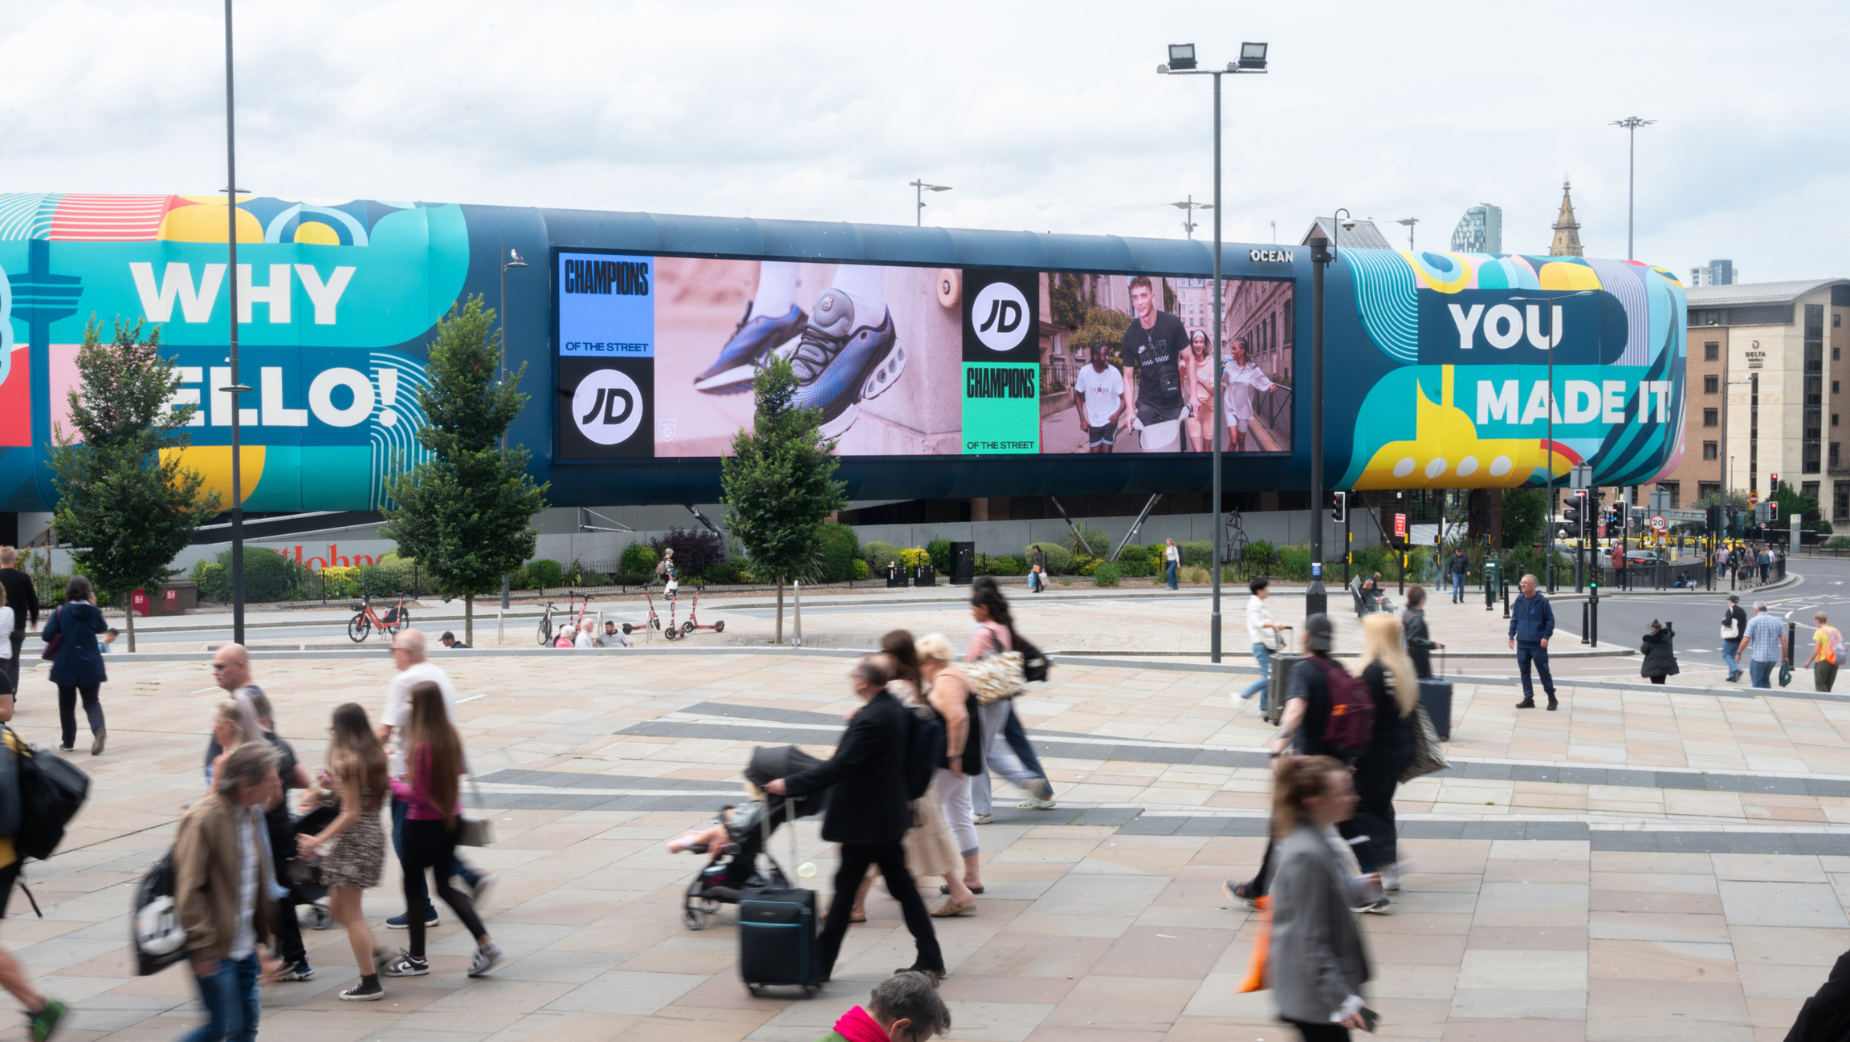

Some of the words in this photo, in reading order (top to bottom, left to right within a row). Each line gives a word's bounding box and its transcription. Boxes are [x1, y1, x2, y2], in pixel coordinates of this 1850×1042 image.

[1251, 249, 1293, 262] OCEAN
[129, 262, 357, 325] WHY
[565, 259, 649, 296] CHAMPIONS
[980, 299, 1022, 333] JD
[1447, 304, 1563, 350] YOU
[565, 341, 581, 351] OF
[582, 342, 605, 351] THE
[606, 342, 649, 352] STREET
[83, 367, 399, 428] ELLO!
[966, 367, 1035, 399] CHAMPIONS
[582, 388, 634, 425] JD
[1476, 380, 1627, 425] MADE
[966, 441, 980, 449] OF
[981, 441, 999, 449] THE
[1000, 441, 1035, 449] STREET
